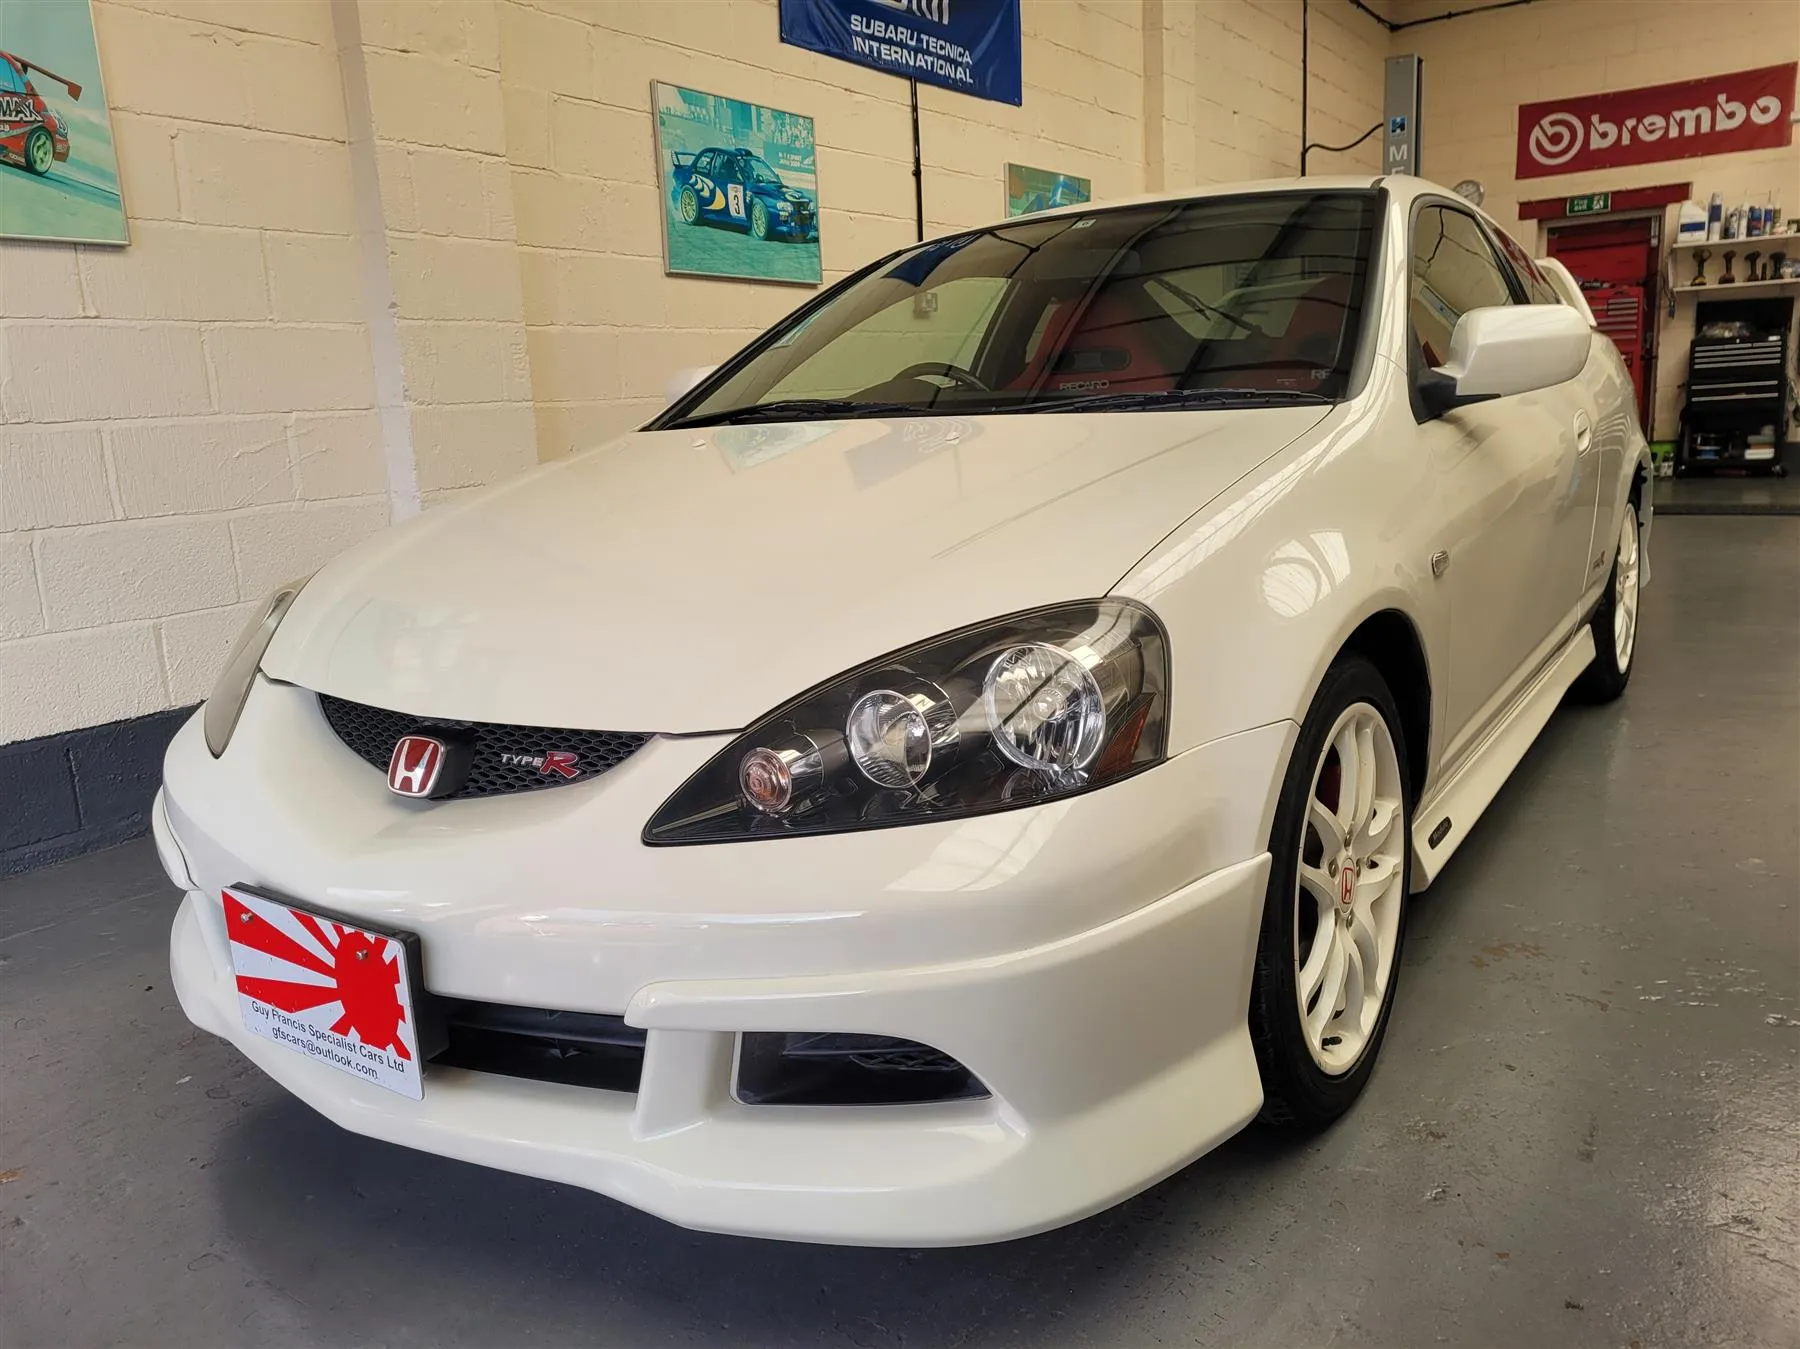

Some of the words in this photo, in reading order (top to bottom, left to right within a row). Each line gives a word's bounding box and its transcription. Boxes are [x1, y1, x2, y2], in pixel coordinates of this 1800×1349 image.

[850, 14, 917, 46] SUBARU
[920, 34, 973, 65] TECNICA
[851, 35, 974, 84] INTERNATIONAL
[1590, 93, 1781, 151] brembo
[733, 194, 741, 215] 3
[1060, 380, 1110, 391] RECARO
[500, 753, 544, 767] TYPE
[540, 750, 580, 779] R
[252, 1000, 270, 1020] Guy
[271, 1008, 307, 1033] Francis
[308, 1024, 358, 1055] Specialist
[359, 1045, 384, 1065] Cars
[386, 1055, 405, 1074] Ltd
[272, 1026, 378, 1080] gfscars@outlook.com
